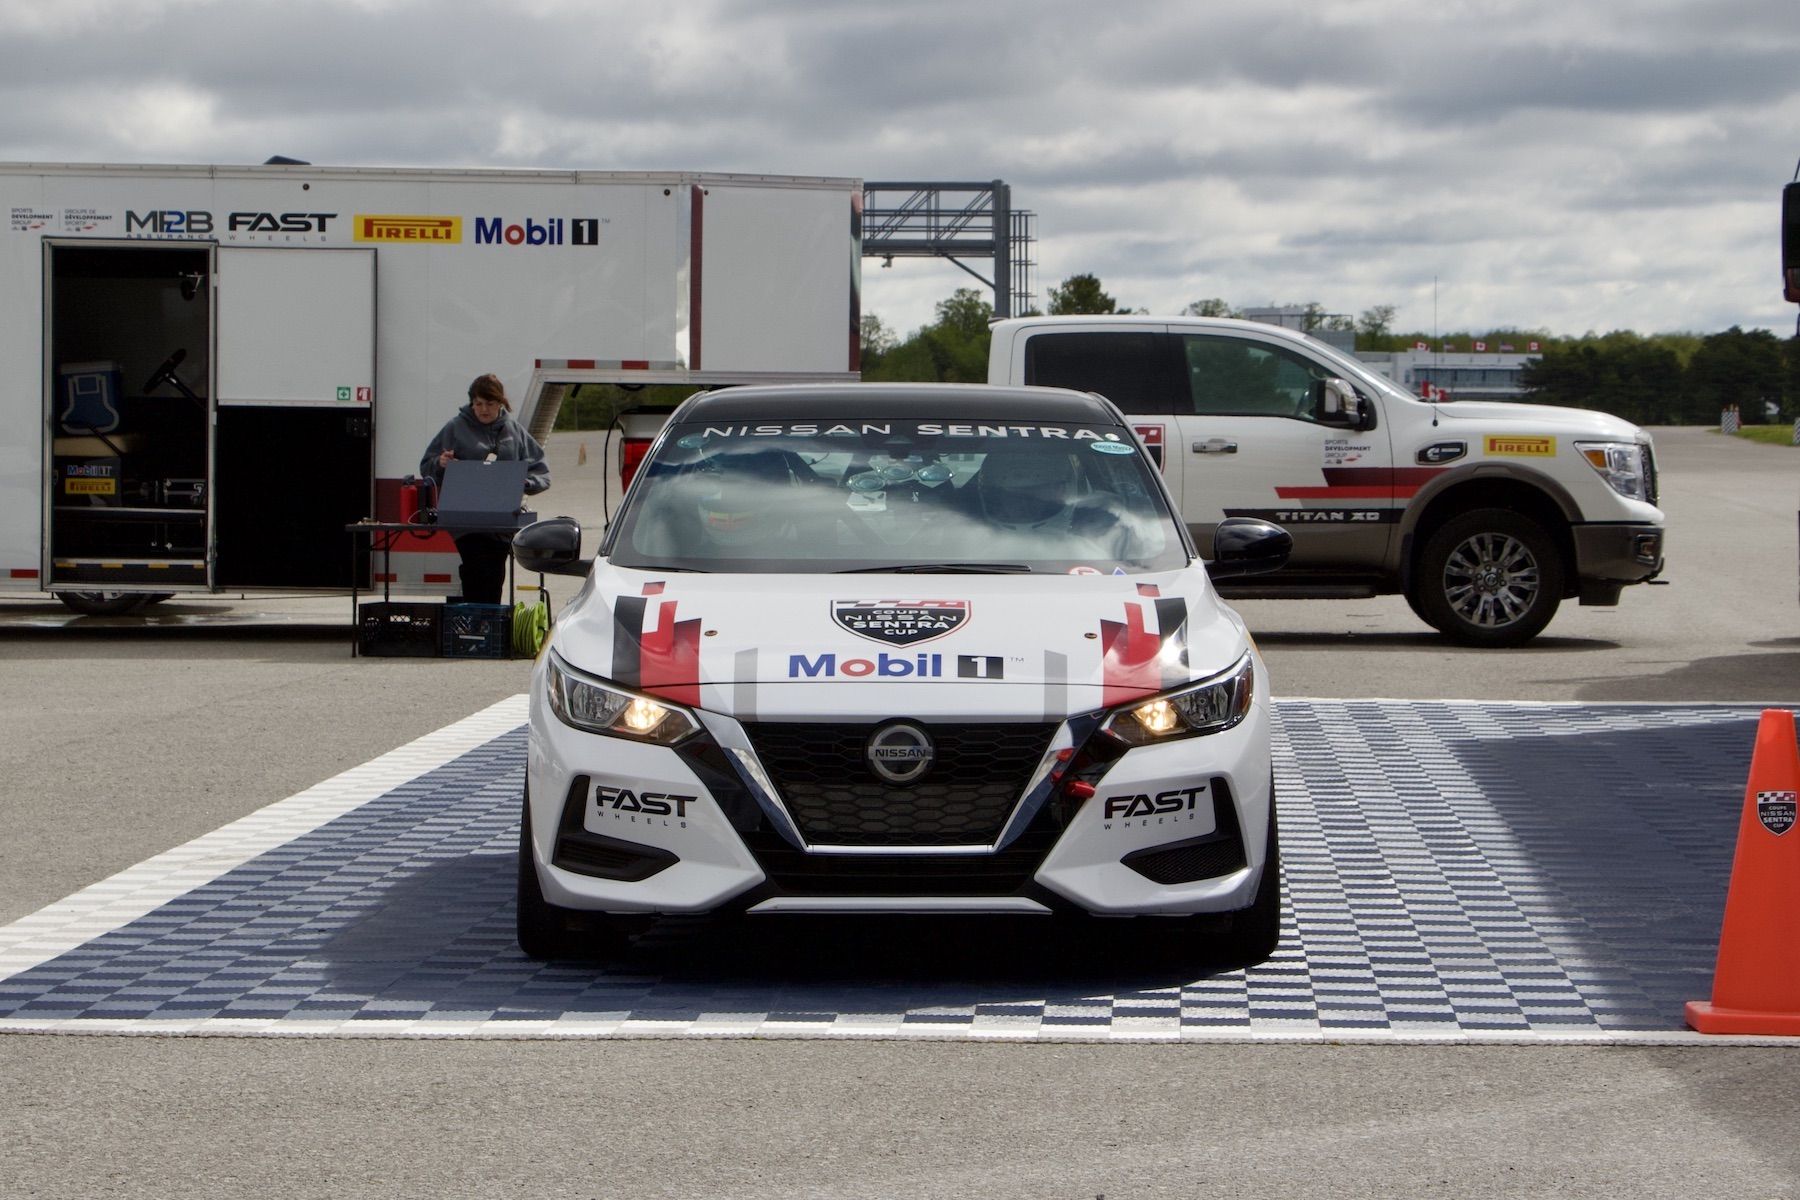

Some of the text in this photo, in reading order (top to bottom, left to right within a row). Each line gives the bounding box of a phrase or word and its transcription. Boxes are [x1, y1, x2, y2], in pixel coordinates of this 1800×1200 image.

[228, 212, 339, 232] FAST
[364, 218, 453, 240] PIRELLI
[474, 217, 564, 246] Mobil
[702, 424, 1104, 441] NISSAN SENTRA
[1489, 438, 1550, 453] PIRELLI
[1275, 511, 1380, 521] TITAN XD
[844, 614, 958, 622] NISSAN
[852, 621, 950, 629] SENTRA
[789, 653, 943, 678] Mobil
[875, 749, 927, 758] NISSAN
[596, 785, 698, 818] FAST
[1104, 786, 1207, 819] FAST
[597, 810, 687, 829] WHEELS
[1104, 813, 1195, 830] WHEELS
